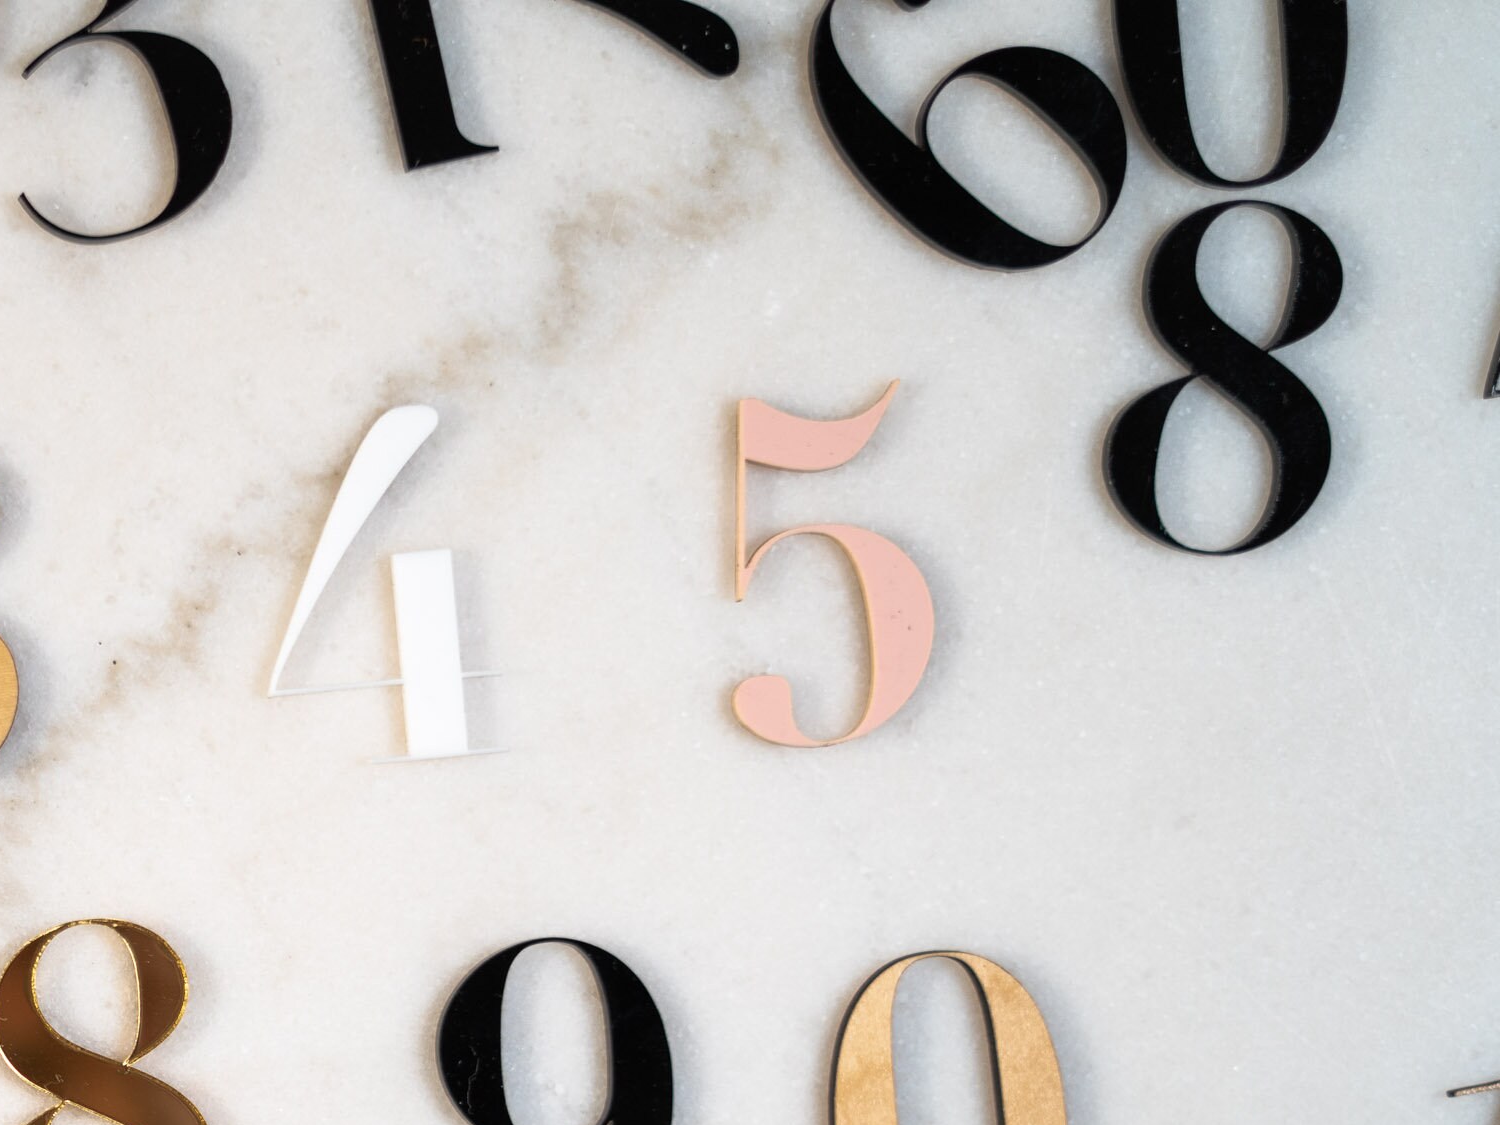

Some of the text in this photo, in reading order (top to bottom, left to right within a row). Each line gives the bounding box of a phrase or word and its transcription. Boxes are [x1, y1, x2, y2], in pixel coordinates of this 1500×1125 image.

[1102, 200, 1344, 556] 8
[265, 404, 508, 760] 4
[730, 378, 937, 747] 5
